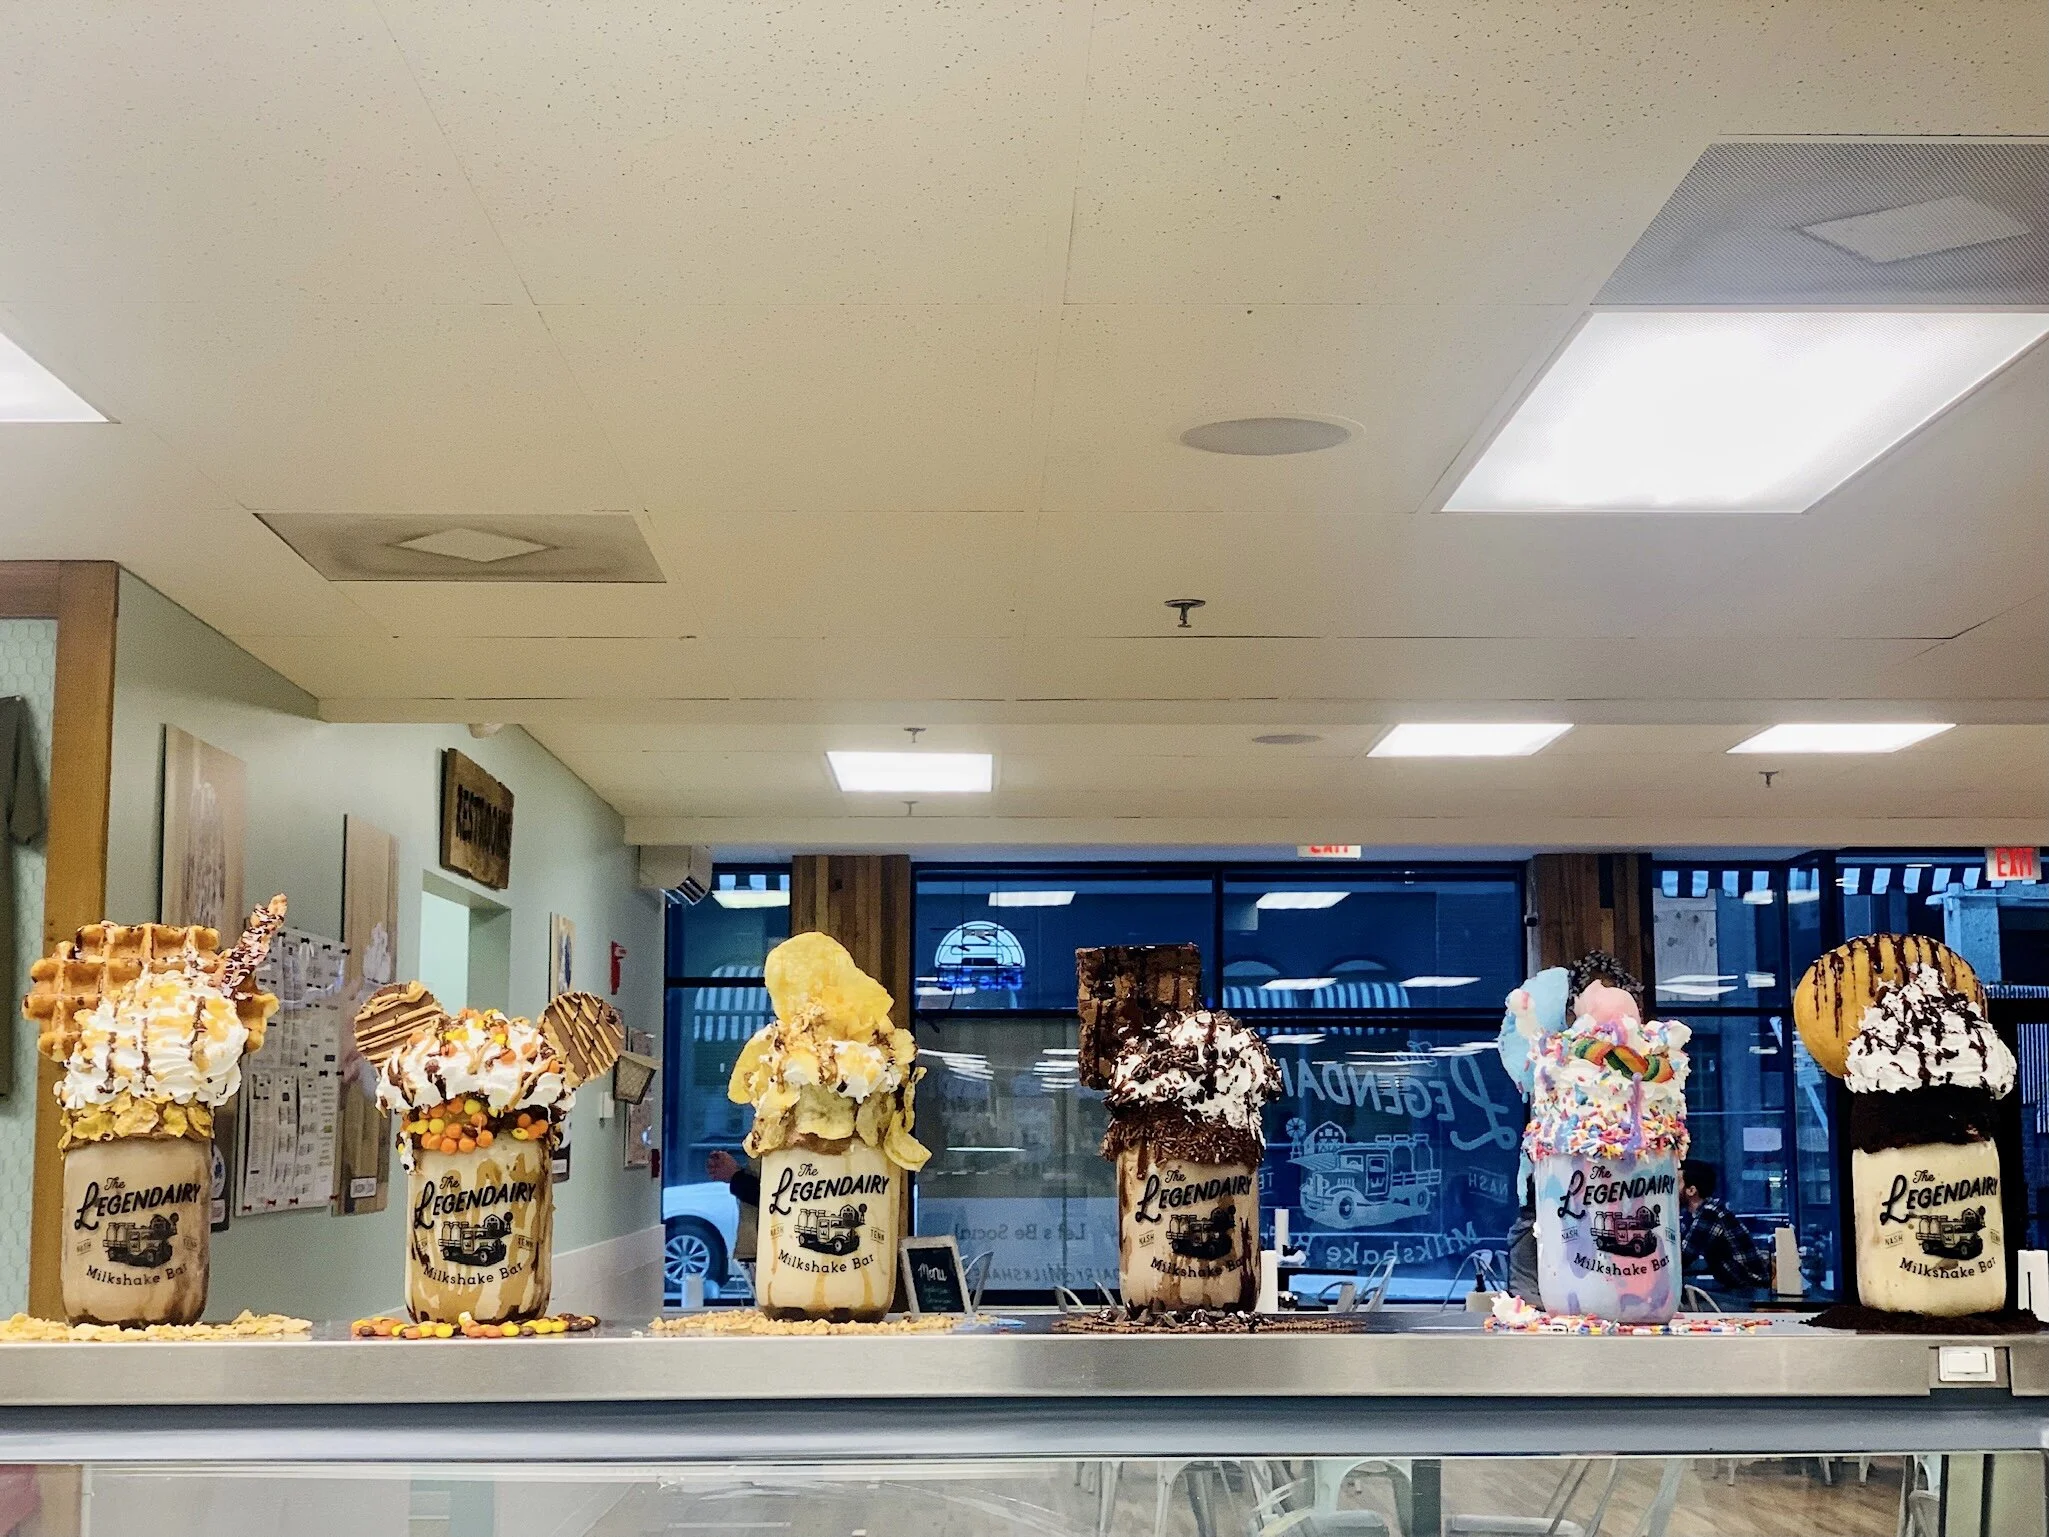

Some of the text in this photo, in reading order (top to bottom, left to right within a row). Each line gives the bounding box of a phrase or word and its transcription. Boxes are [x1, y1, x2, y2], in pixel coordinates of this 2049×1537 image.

[1996, 847, 2033, 877] EXIT
[440, 1175, 460, 1188] The
[798, 1163, 819, 1177] The
[1164, 1169, 1187, 1184] The
[1590, 1165, 1612, 1180] The
[1912, 1169, 1936, 1184] The
[104, 1177, 126, 1191] The
[769, 1167, 890, 1216] LEGENDAIRY
[1557, 1170, 1676, 1220] LEGENDAIRY
[74, 1182, 201, 1231] LEGENDAIRY
[413, 1181, 536, 1230] LEGENDAIRY
[1135, 1174, 1253, 1223] LEGENDAIRY
[1880, 1174, 1999, 1226] LEGENDAIRY
[778, 1249, 874, 1273] Milkshake Bar
[917, 1262, 948, 1281] Menu
[1150, 1256, 1247, 1278] Milkshake Ba
[1573, 1252, 1670, 1276] Milkshake Bar
[1899, 1257, 1996, 1279] Milkshake Bar
[86, 1263, 188, 1286] Milkshake Bar
[423, 1262, 522, 1285] Milkshake Bar
